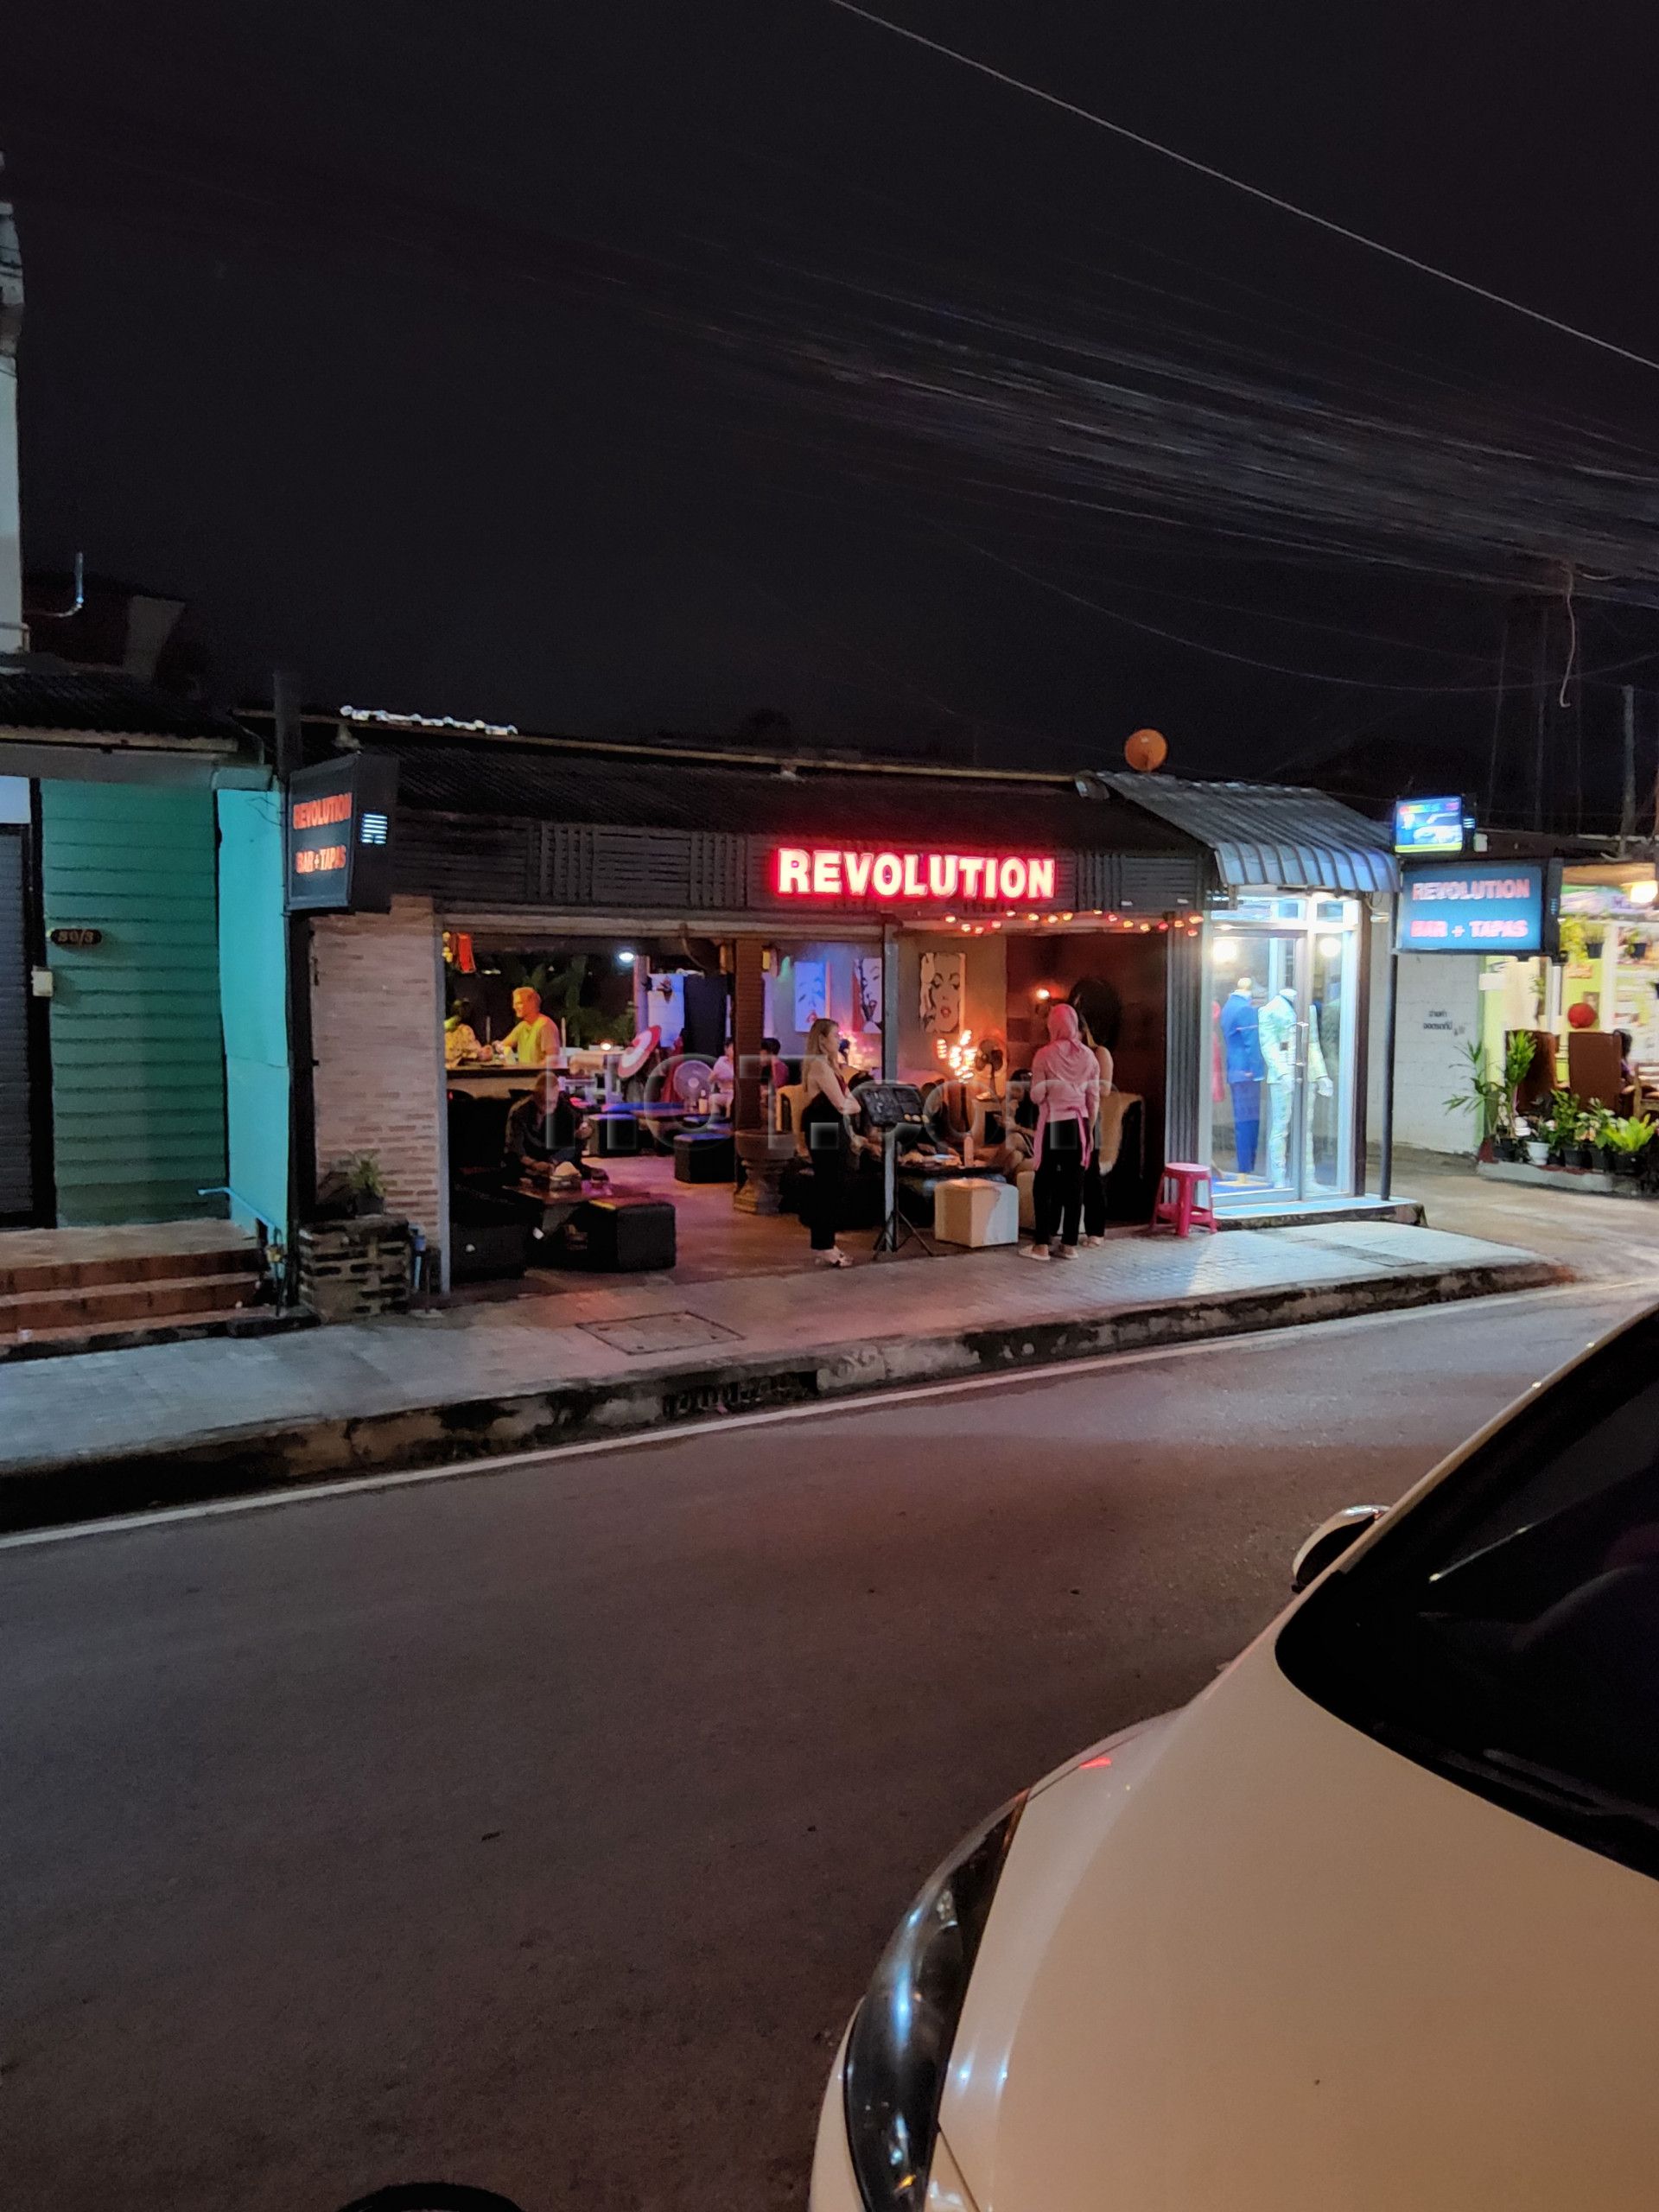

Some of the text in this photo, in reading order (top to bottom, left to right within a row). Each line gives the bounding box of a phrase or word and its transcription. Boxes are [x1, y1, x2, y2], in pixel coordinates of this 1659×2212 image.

[320, 845, 346, 871] TAPAS
[779, 848, 1055, 899] REVOLUTION
[1412, 878, 1530, 900] REVOLUTION
[1410, 919, 1529, 938] BAR + TAPAS
